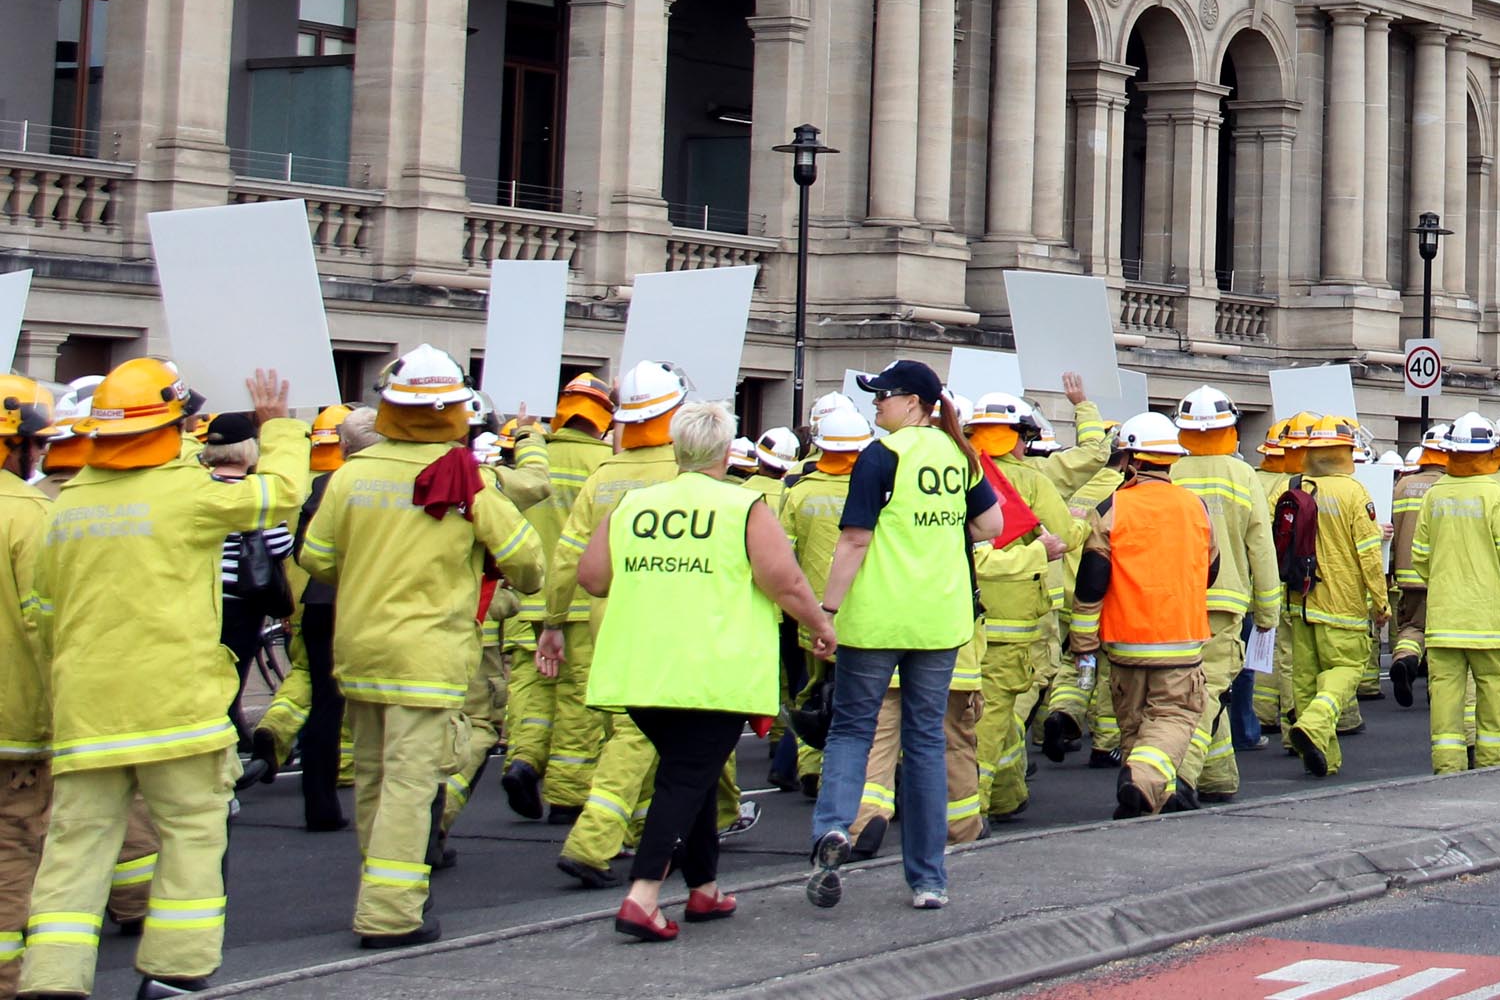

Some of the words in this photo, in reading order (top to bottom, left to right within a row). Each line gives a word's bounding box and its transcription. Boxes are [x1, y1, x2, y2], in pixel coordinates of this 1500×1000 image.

[1410, 356, 1435, 377] 40
[632, 508, 716, 540] QCU
[625, 556, 714, 574] MARSHAL
